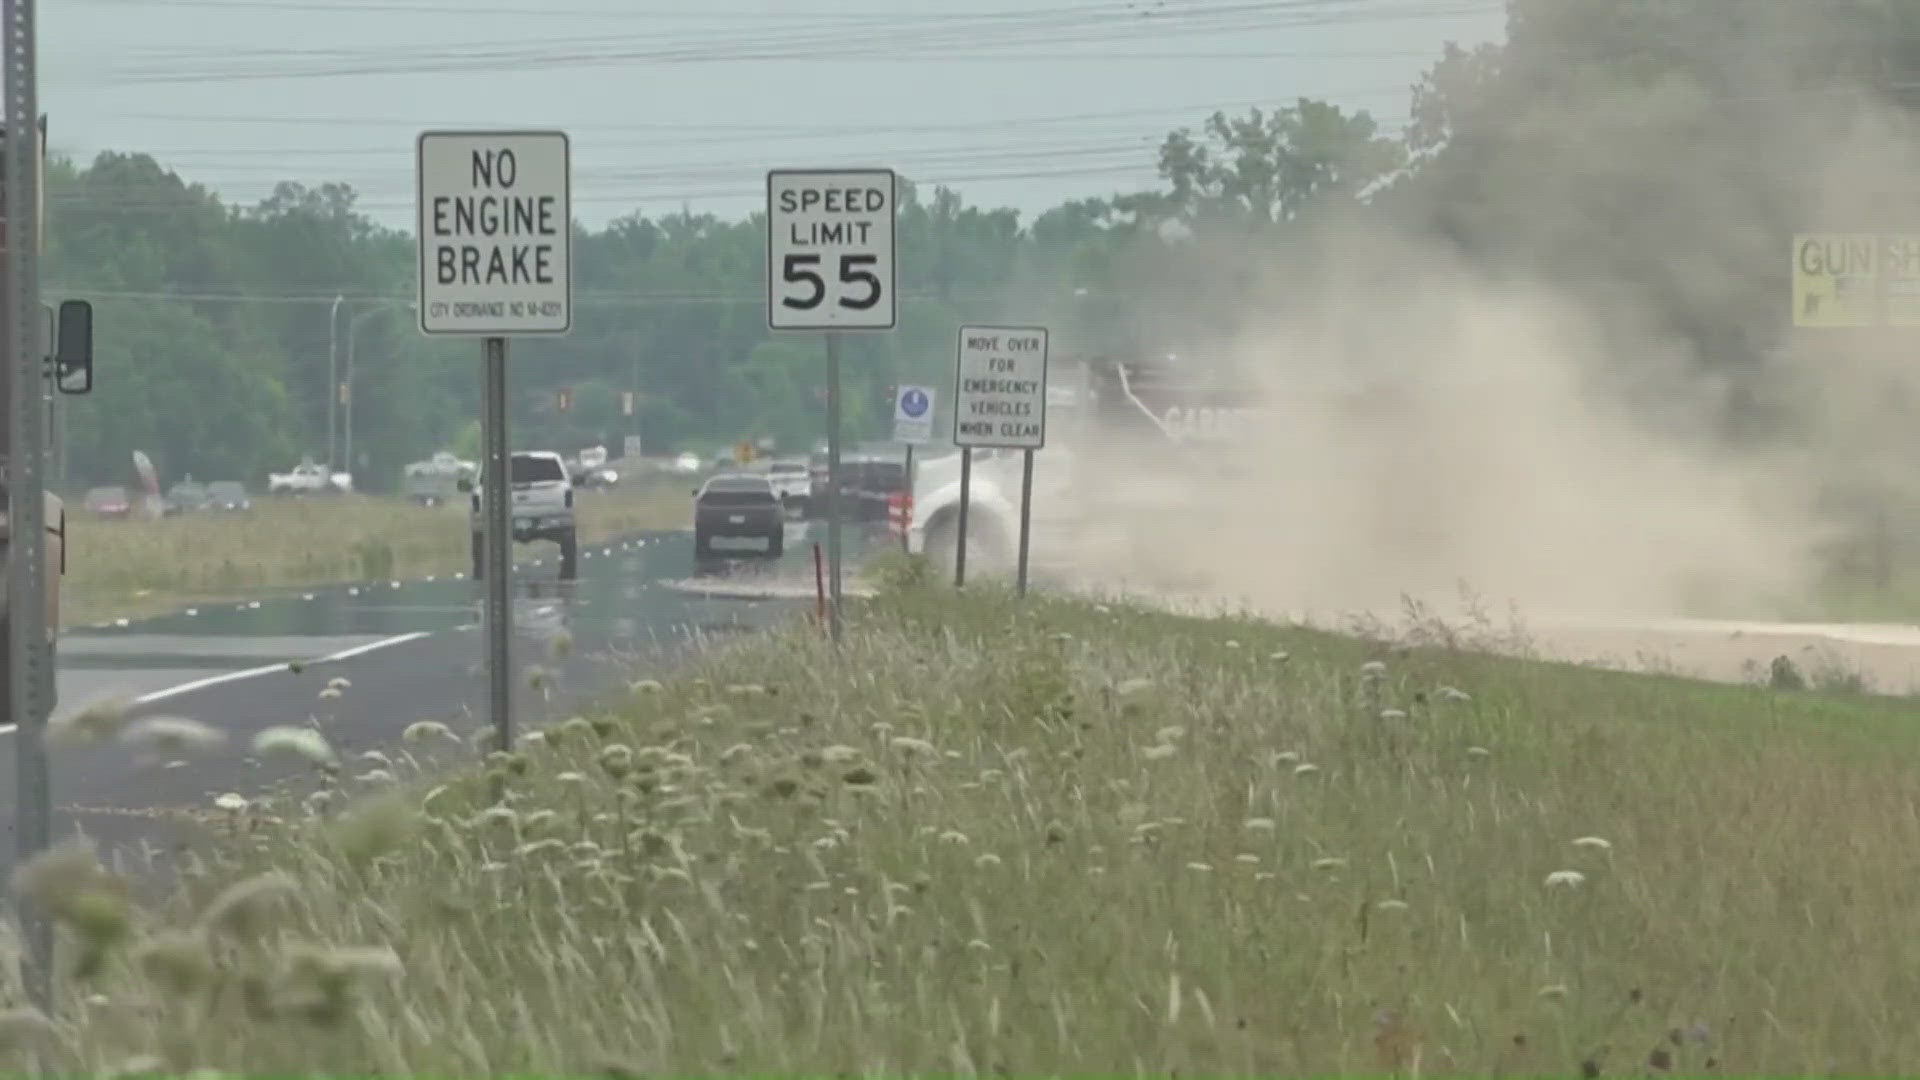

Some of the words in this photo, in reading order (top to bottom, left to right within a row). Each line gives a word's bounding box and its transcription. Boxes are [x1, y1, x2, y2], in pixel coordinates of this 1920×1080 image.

[472, 148, 516, 188] NO
[779, 189, 885, 213] SPEED
[434, 196, 556, 236] ENGINE
[791, 222, 872, 245] LIMIT
[437, 246, 553, 285] BRAKE
[1801, 239, 1872, 275] GUN
[782, 254, 882, 310] 55
[967, 337, 998, 351] MOVE
[1008, 338, 1039, 352] OVER
[989, 358, 1015, 372] FOR
[964, 380, 1038, 393] EMERGENCY
[970, 401, 1031, 416] VEHICLES
[960, 422, 992, 436] WHEN
[1001, 423, 1039, 437] CLEAR
